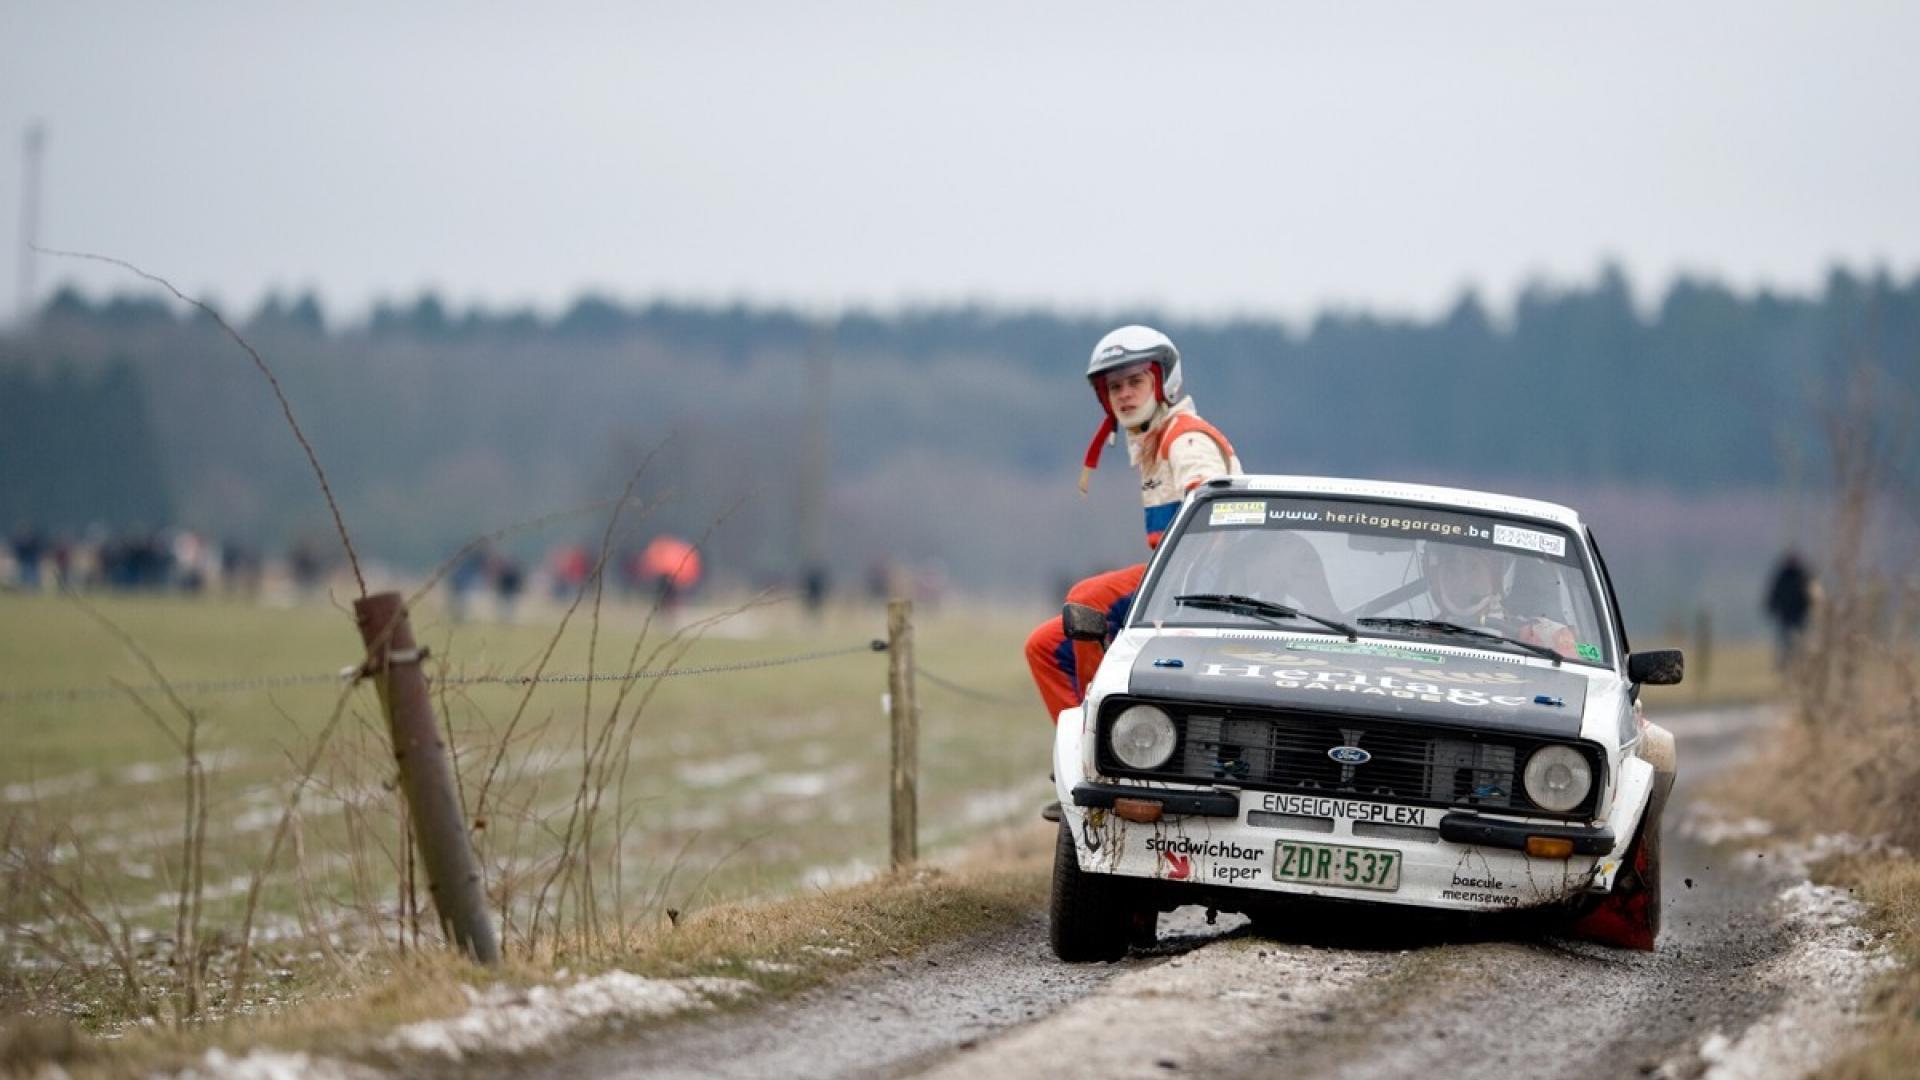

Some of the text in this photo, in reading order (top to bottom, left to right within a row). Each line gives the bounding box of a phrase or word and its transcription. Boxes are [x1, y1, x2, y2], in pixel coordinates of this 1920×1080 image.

[1198, 663, 1527, 706] Heritage
[1275, 679, 1441, 703] GARAGE
[1146, 837, 1264, 861] sandwichbar
[1213, 862, 1262, 883] ieper
[1452, 873, 1503, 890] bascule
[1442, 889, 1519, 907] meenseweg
